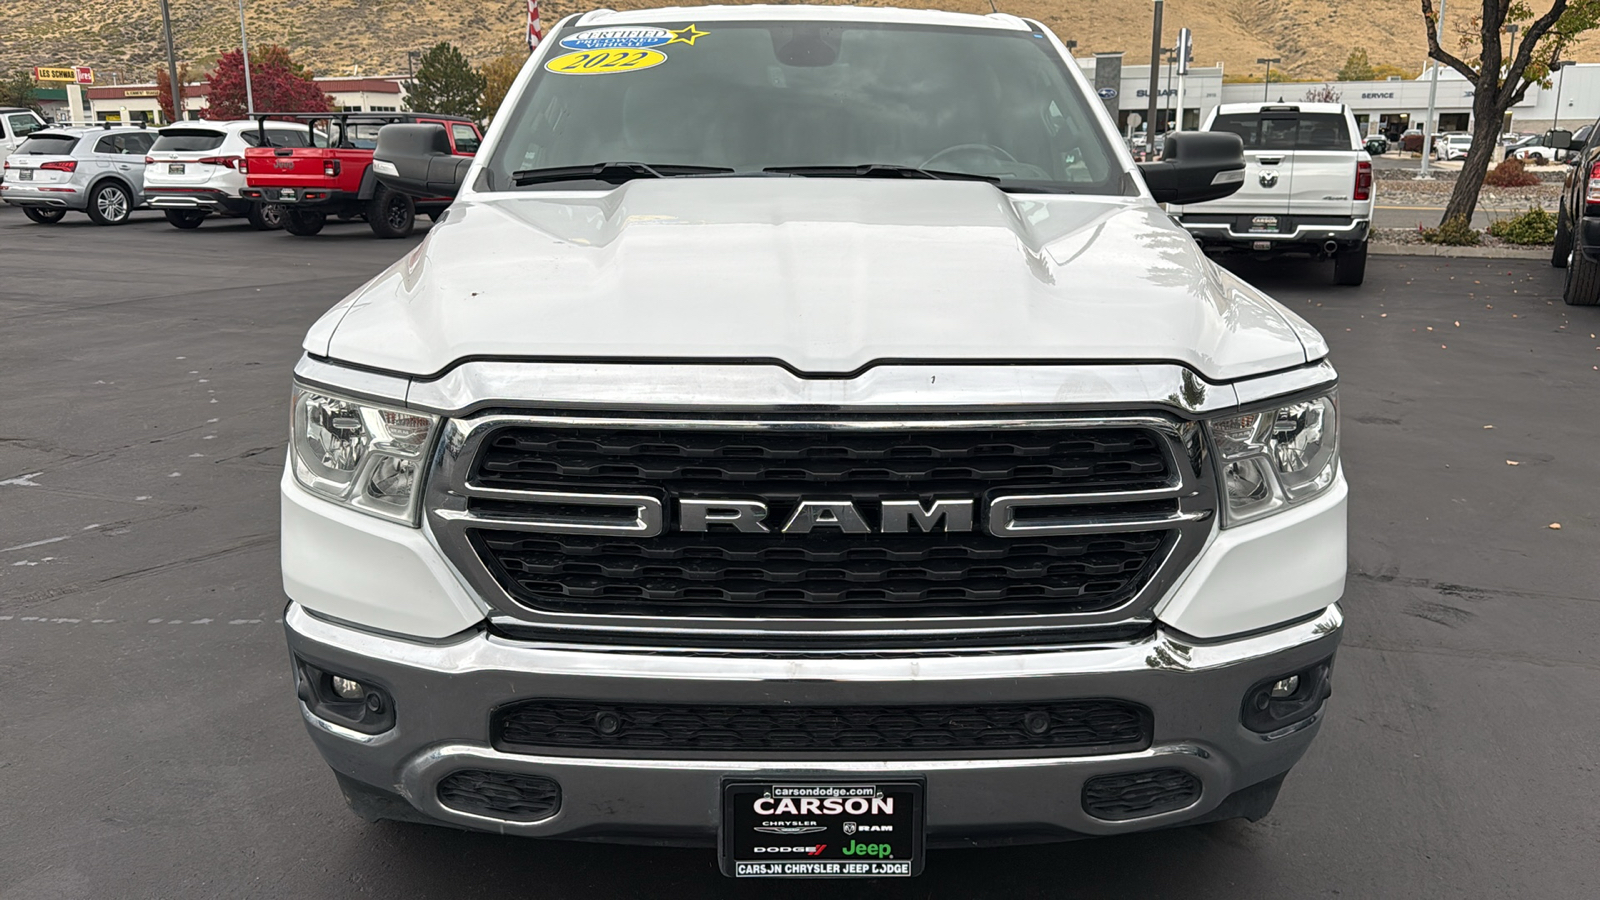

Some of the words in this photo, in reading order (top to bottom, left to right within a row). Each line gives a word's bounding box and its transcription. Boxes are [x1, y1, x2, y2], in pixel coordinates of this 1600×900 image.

[576, 30, 667, 39] CERTIFIED
[576, 38, 658, 46] PRE-OWNED
[561, 52, 648, 70] 2022
[39, 69, 50, 78] LES
[51, 70, 75, 79] SCHWAB
[273, 159, 295, 170] Jeep
[679, 499, 973, 533] RAM
[775, 788, 873, 797] carsondodge.com
[753, 797, 893, 815] CARSON
[842, 839, 891, 858] Jeep
[784, 864, 841, 874] CHRYSLER
[843, 864, 869, 874] JEEP
